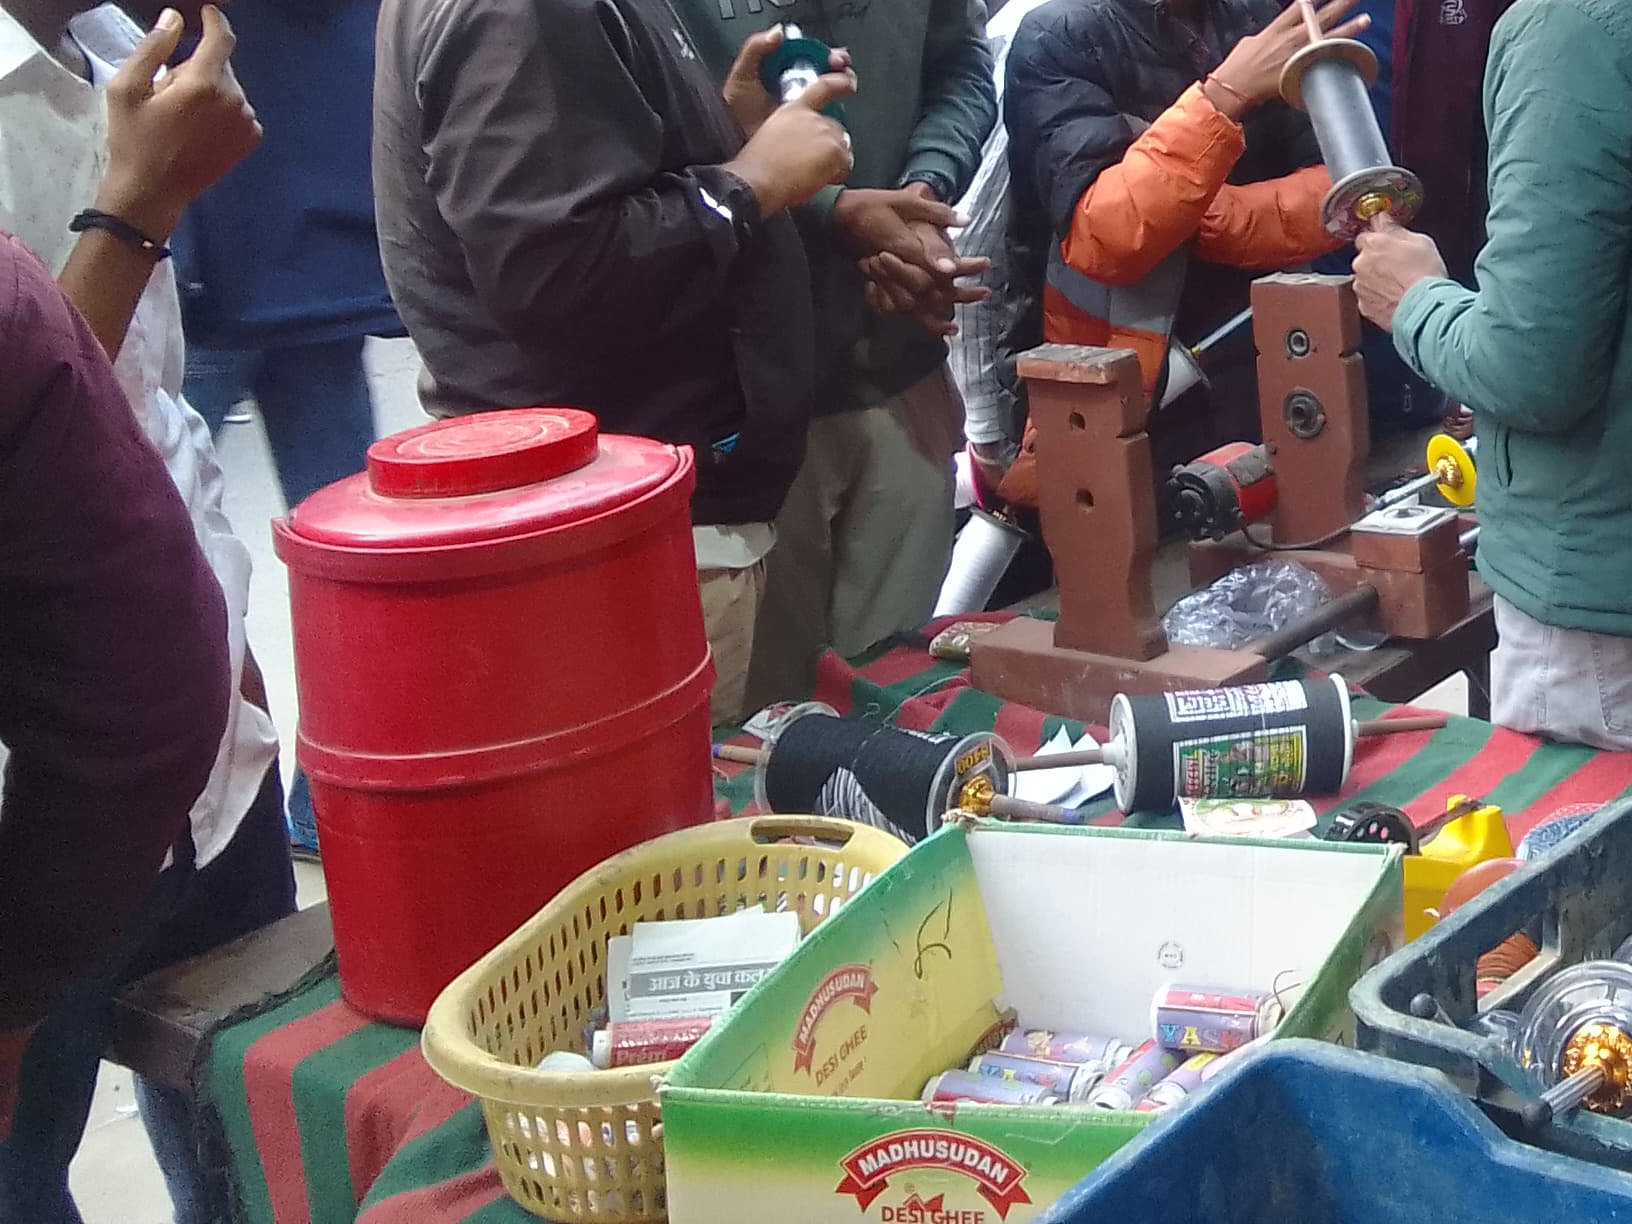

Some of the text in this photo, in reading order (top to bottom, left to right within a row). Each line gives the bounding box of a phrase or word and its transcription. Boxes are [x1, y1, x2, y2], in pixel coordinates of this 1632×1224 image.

[649, 974, 681, 992] आज
[684, 970, 700, 988] के
[704, 970, 731, 990] युवा
[799, 974, 865, 1044] MADHUSUDAN
[815, 1052, 839, 1088] DESI
[840, 1024, 868, 1061] GHEE
[857, 1140, 1008, 1183] MADHUSUDAN
[881, 1206, 925, 1224] DESI
